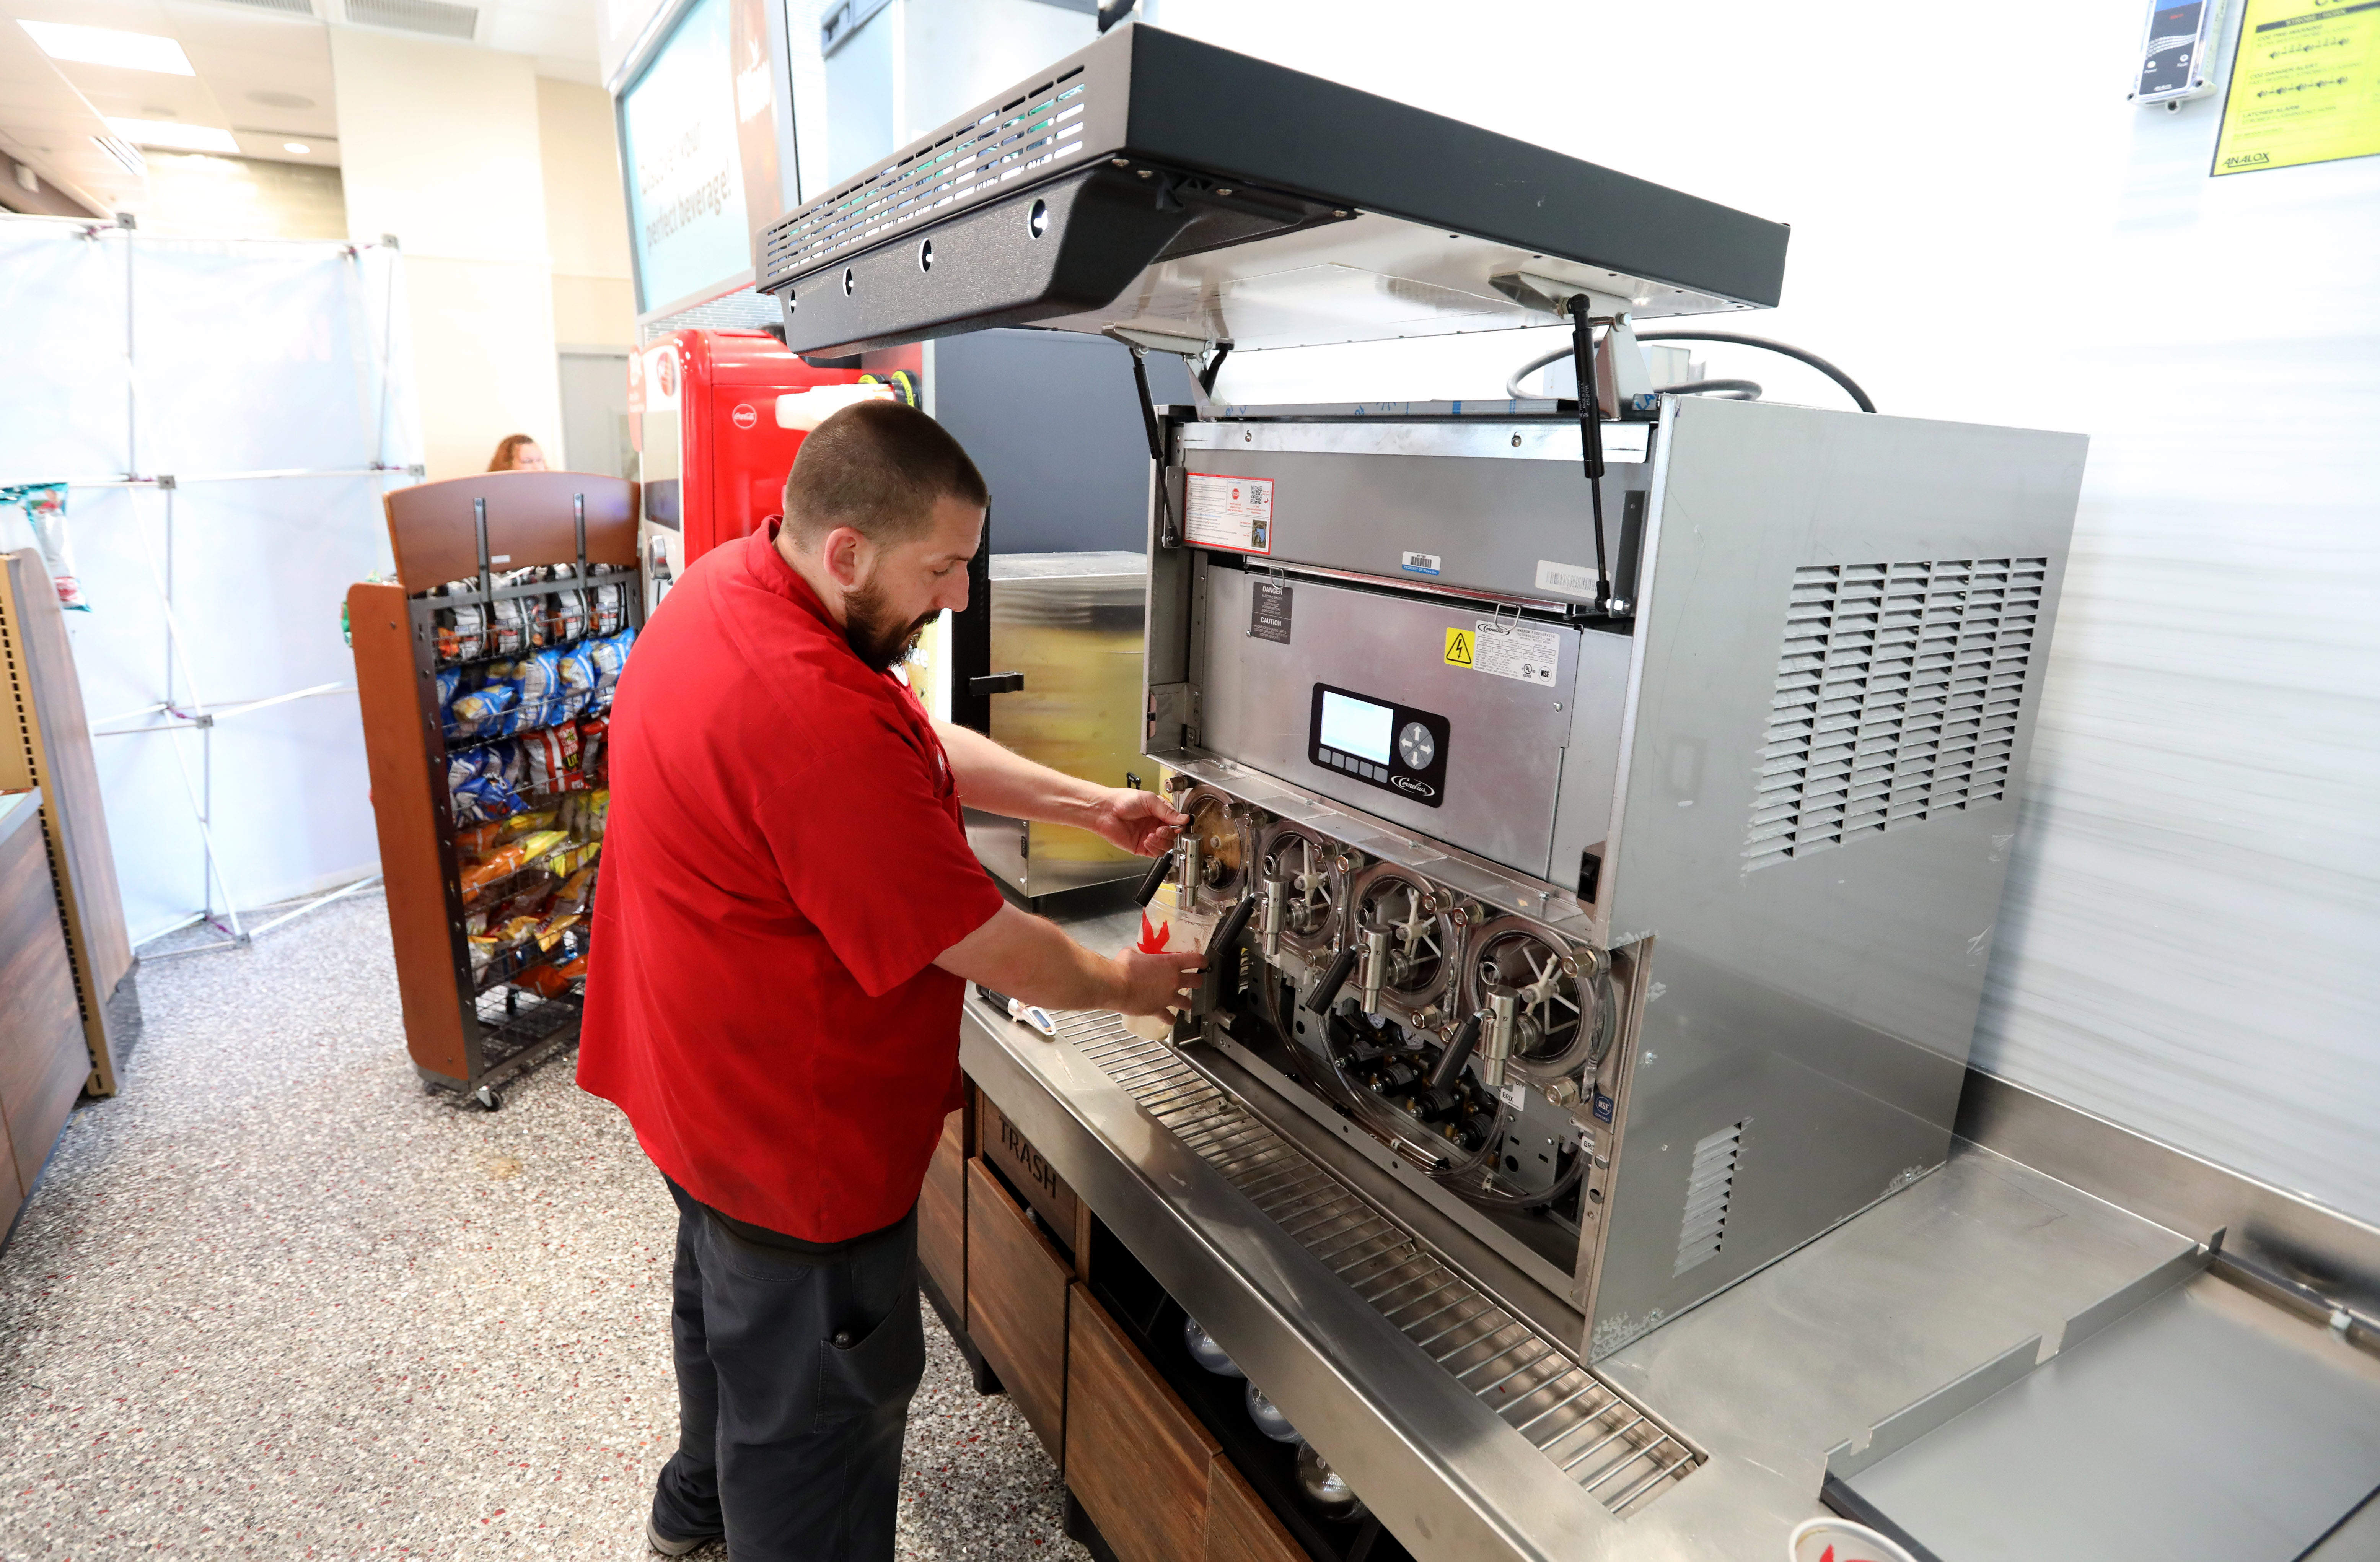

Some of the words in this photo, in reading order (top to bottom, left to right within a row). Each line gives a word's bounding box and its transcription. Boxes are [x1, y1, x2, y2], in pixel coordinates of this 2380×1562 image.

[2223, 152, 2270, 168] ANALOX
[645, 201, 678, 256] perfect
[1262, 586, 1282, 595] DANGER
[1260, 617, 1282, 626] CAUTION
[1541, 669, 1550, 678] NSF
[1398, 777, 1426, 792] Cornelius
[1502, 1092, 1513, 1102] BRIX
[1598, 1100, 1609, 1111] NSF
[999, 1116, 1056, 1199] TRASH
